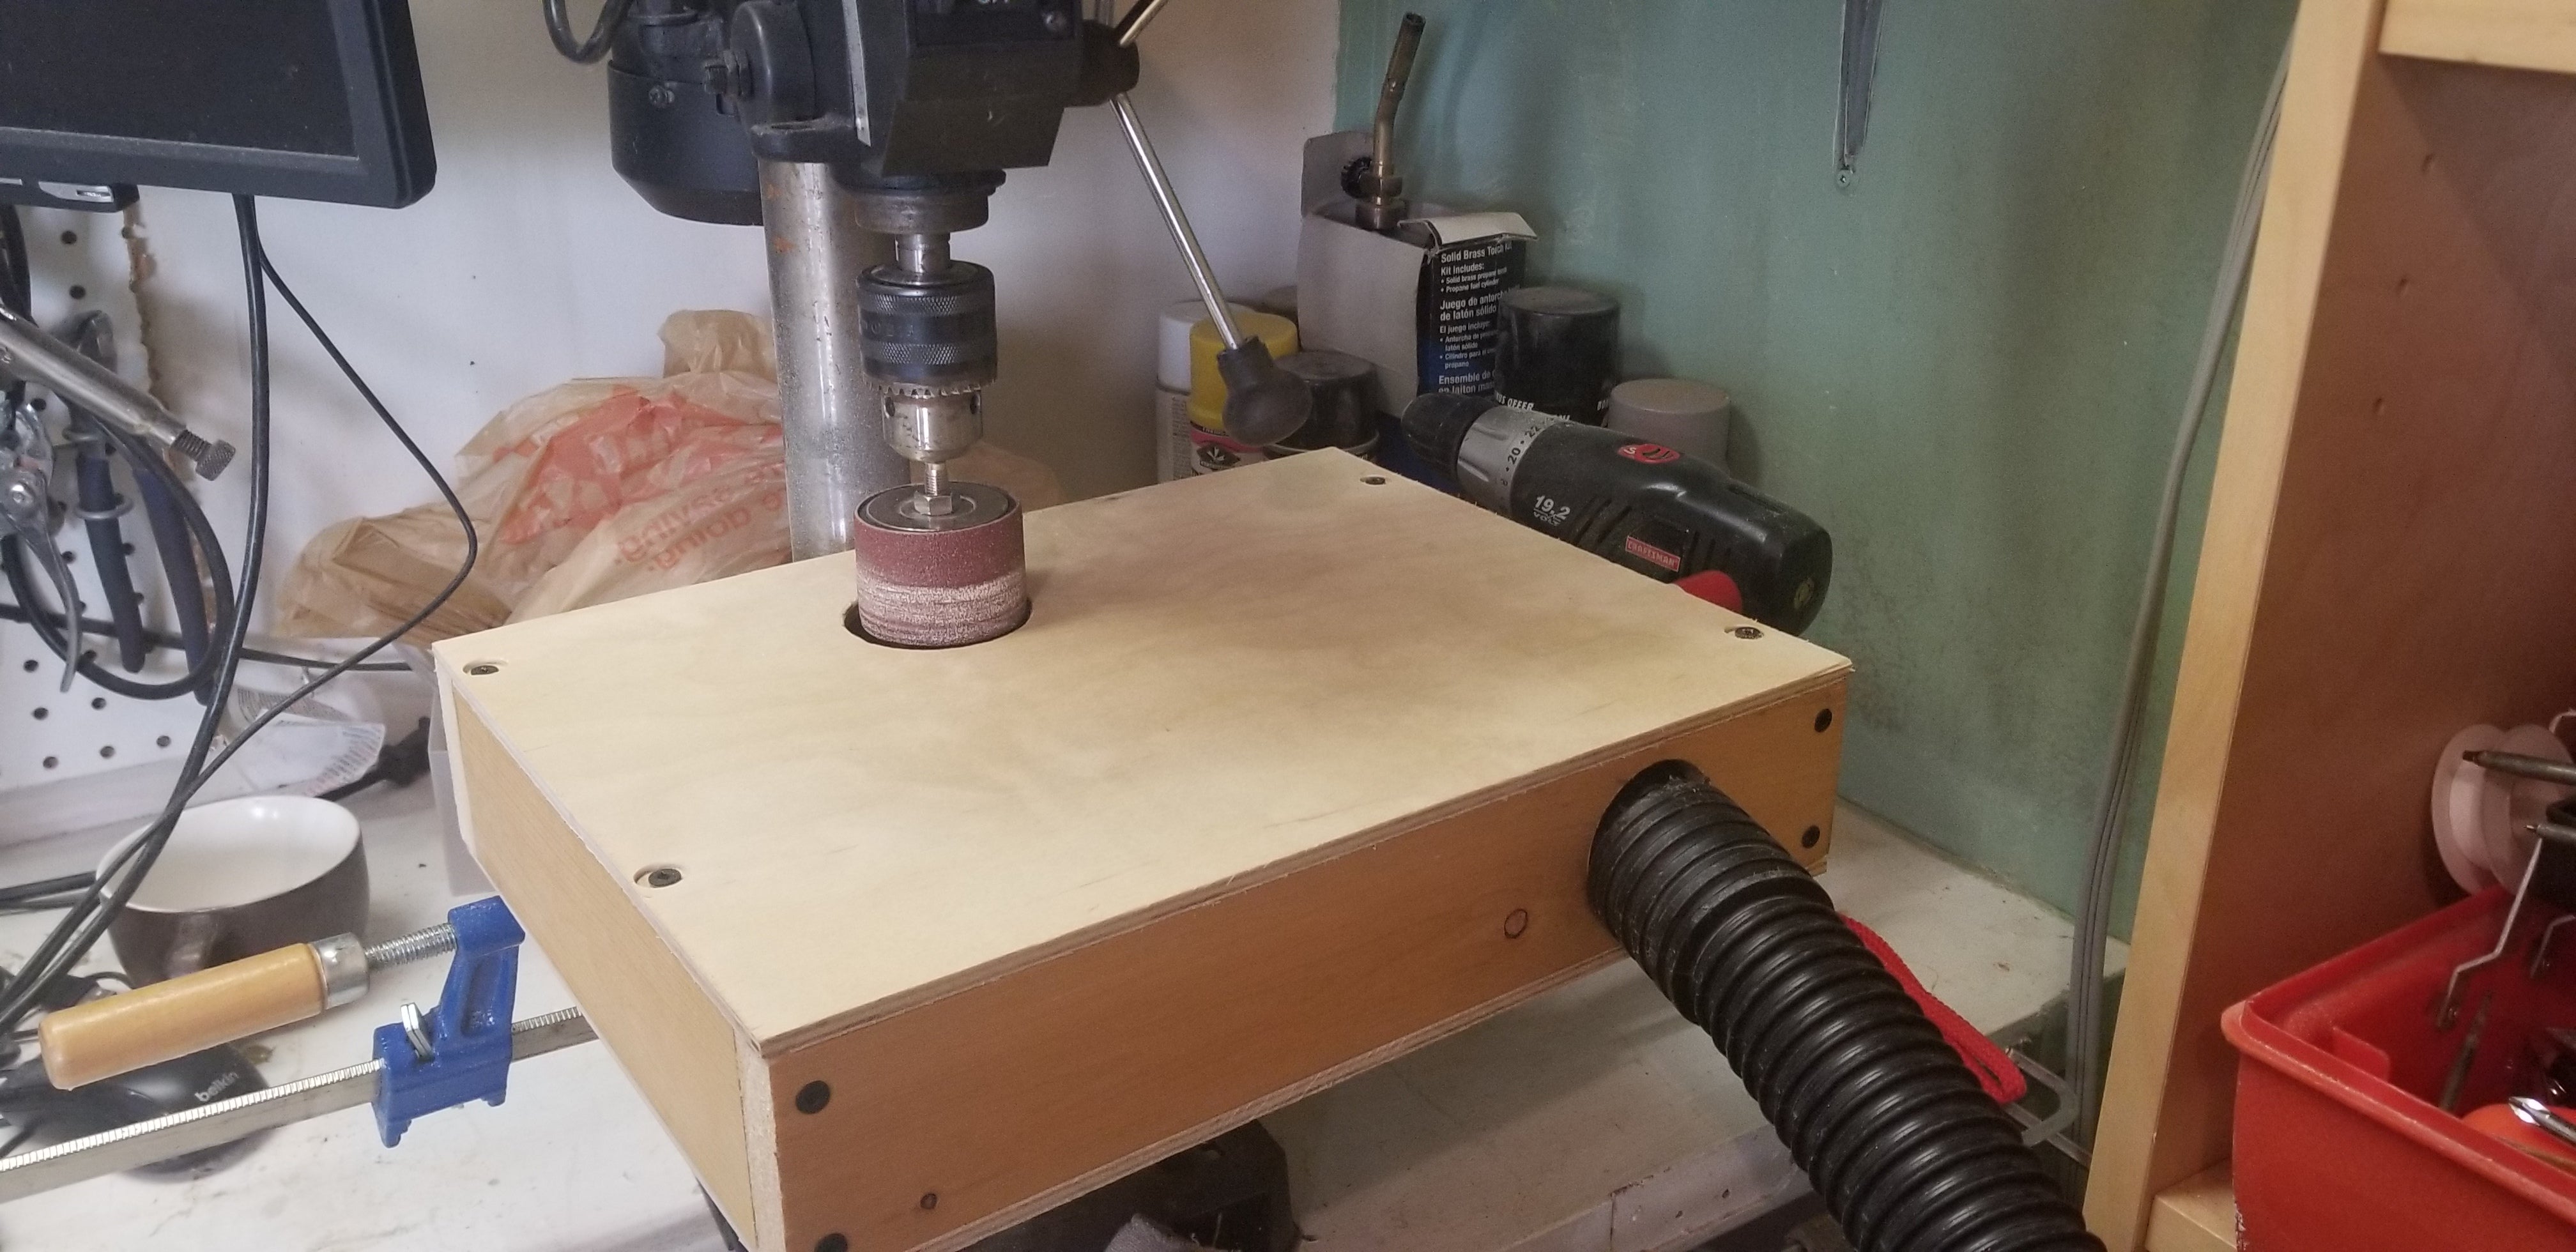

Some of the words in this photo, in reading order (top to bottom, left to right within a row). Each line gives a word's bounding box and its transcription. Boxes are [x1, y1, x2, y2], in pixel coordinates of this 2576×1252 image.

[1441, 250, 1462, 263] Solid
[1463, 248, 1485, 259] Brass
[1441, 266, 1451, 276] Kit
[1453, 263, 1484, 275] Includes:
[1446, 276, 1460, 284] Solid
[1461, 274, 1476, 282] brass
[1446, 284, 1469, 293] Propane
[1440, 300, 1466, 310] Juego
[1468, 296, 1478, 307] de
[1440, 311, 1451, 321] de
[1453, 309, 1474, 320] latón
[1476, 304, 1497, 317] sólido
[1448, 324, 1467, 335] juego
[1445, 334, 1471, 344] Antorcha
[1445, 361, 1469, 370] propano
[1439, 372, 1480, 385] Ensemble
[1482, 370, 1491, 380] de
[1506, 397, 1535, 411] OFFER
[1507, 447, 1521, 465] 20
[1535, 495, 1571, 521] 19.2
[1533, 511, 1561, 526] VOLT
[194, 1071, 240, 1103] belkin
